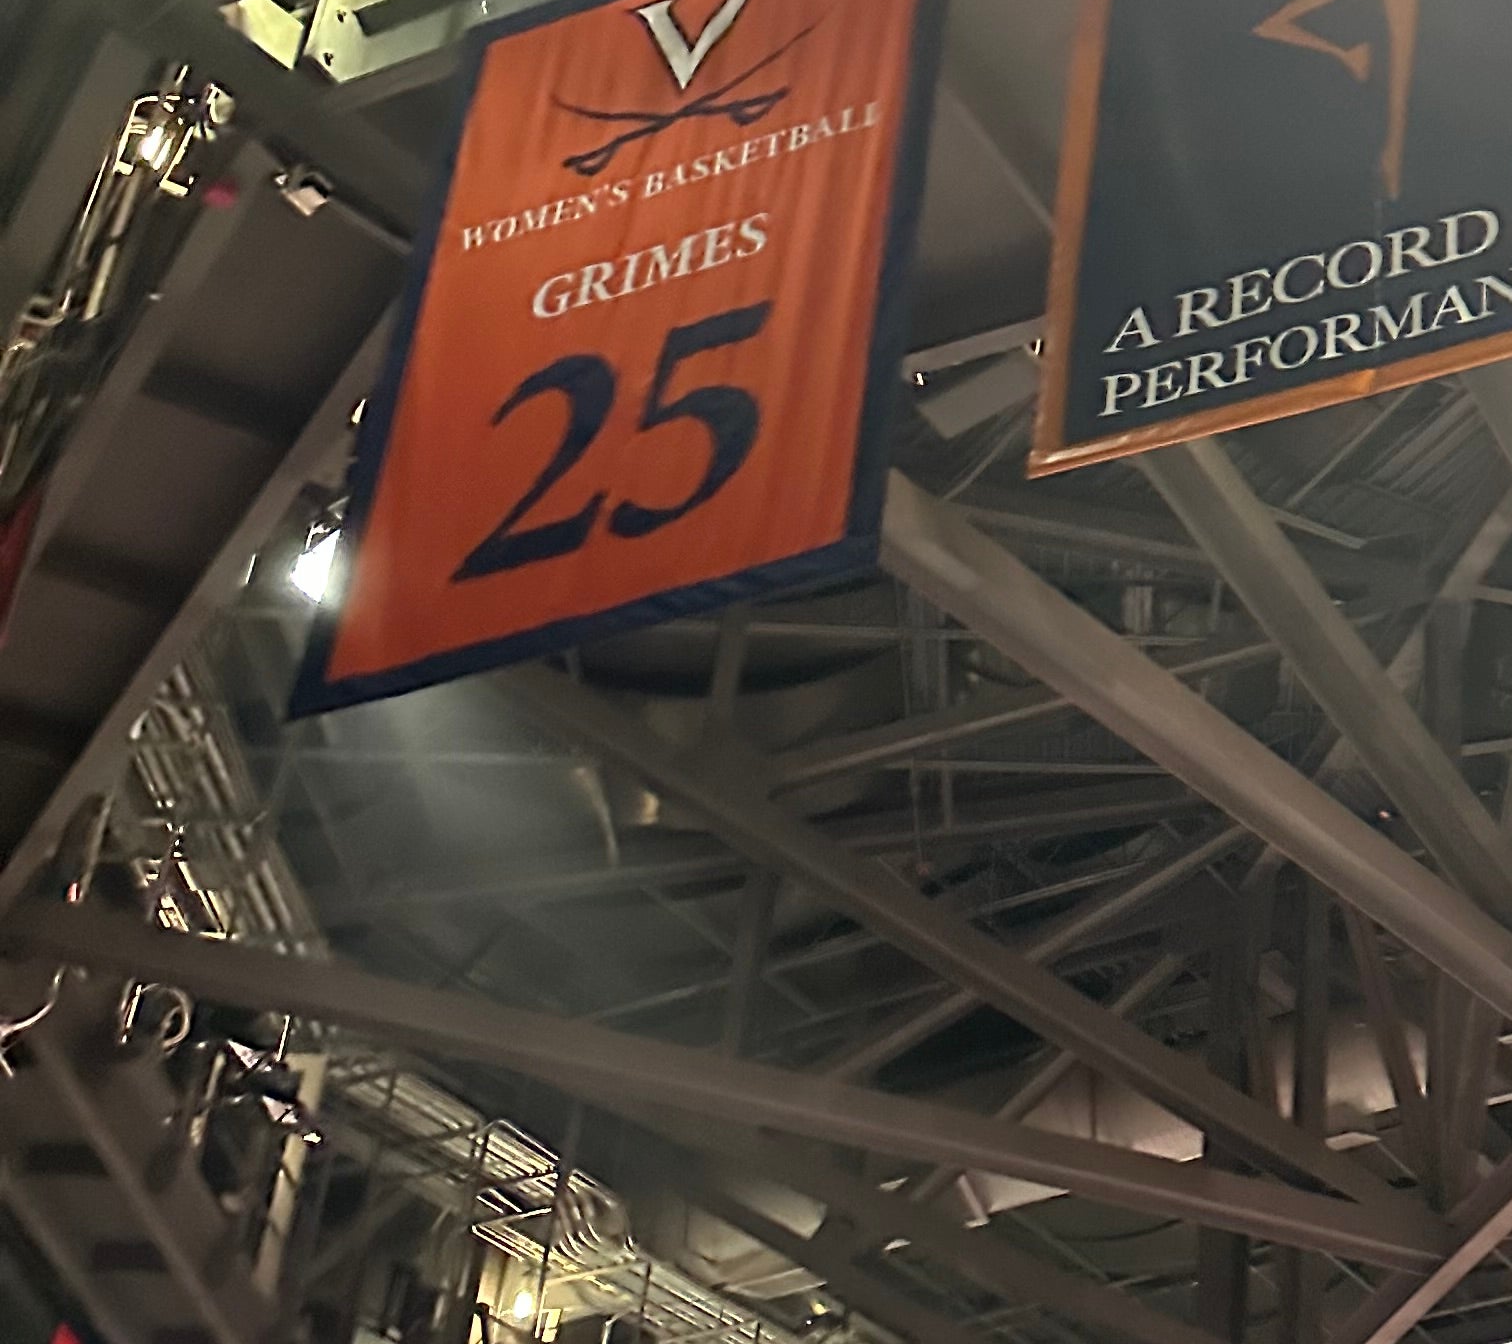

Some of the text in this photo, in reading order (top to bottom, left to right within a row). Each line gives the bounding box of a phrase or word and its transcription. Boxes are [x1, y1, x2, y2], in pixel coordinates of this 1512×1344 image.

[460, 100, 883, 252] WOMEN'S BASKETBALL
[531, 214, 770, 319] GRIMES
[1104, 303, 1170, 355] A
[1175, 208, 1501, 338] RECORD
[449, 300, 774, 584] 25
